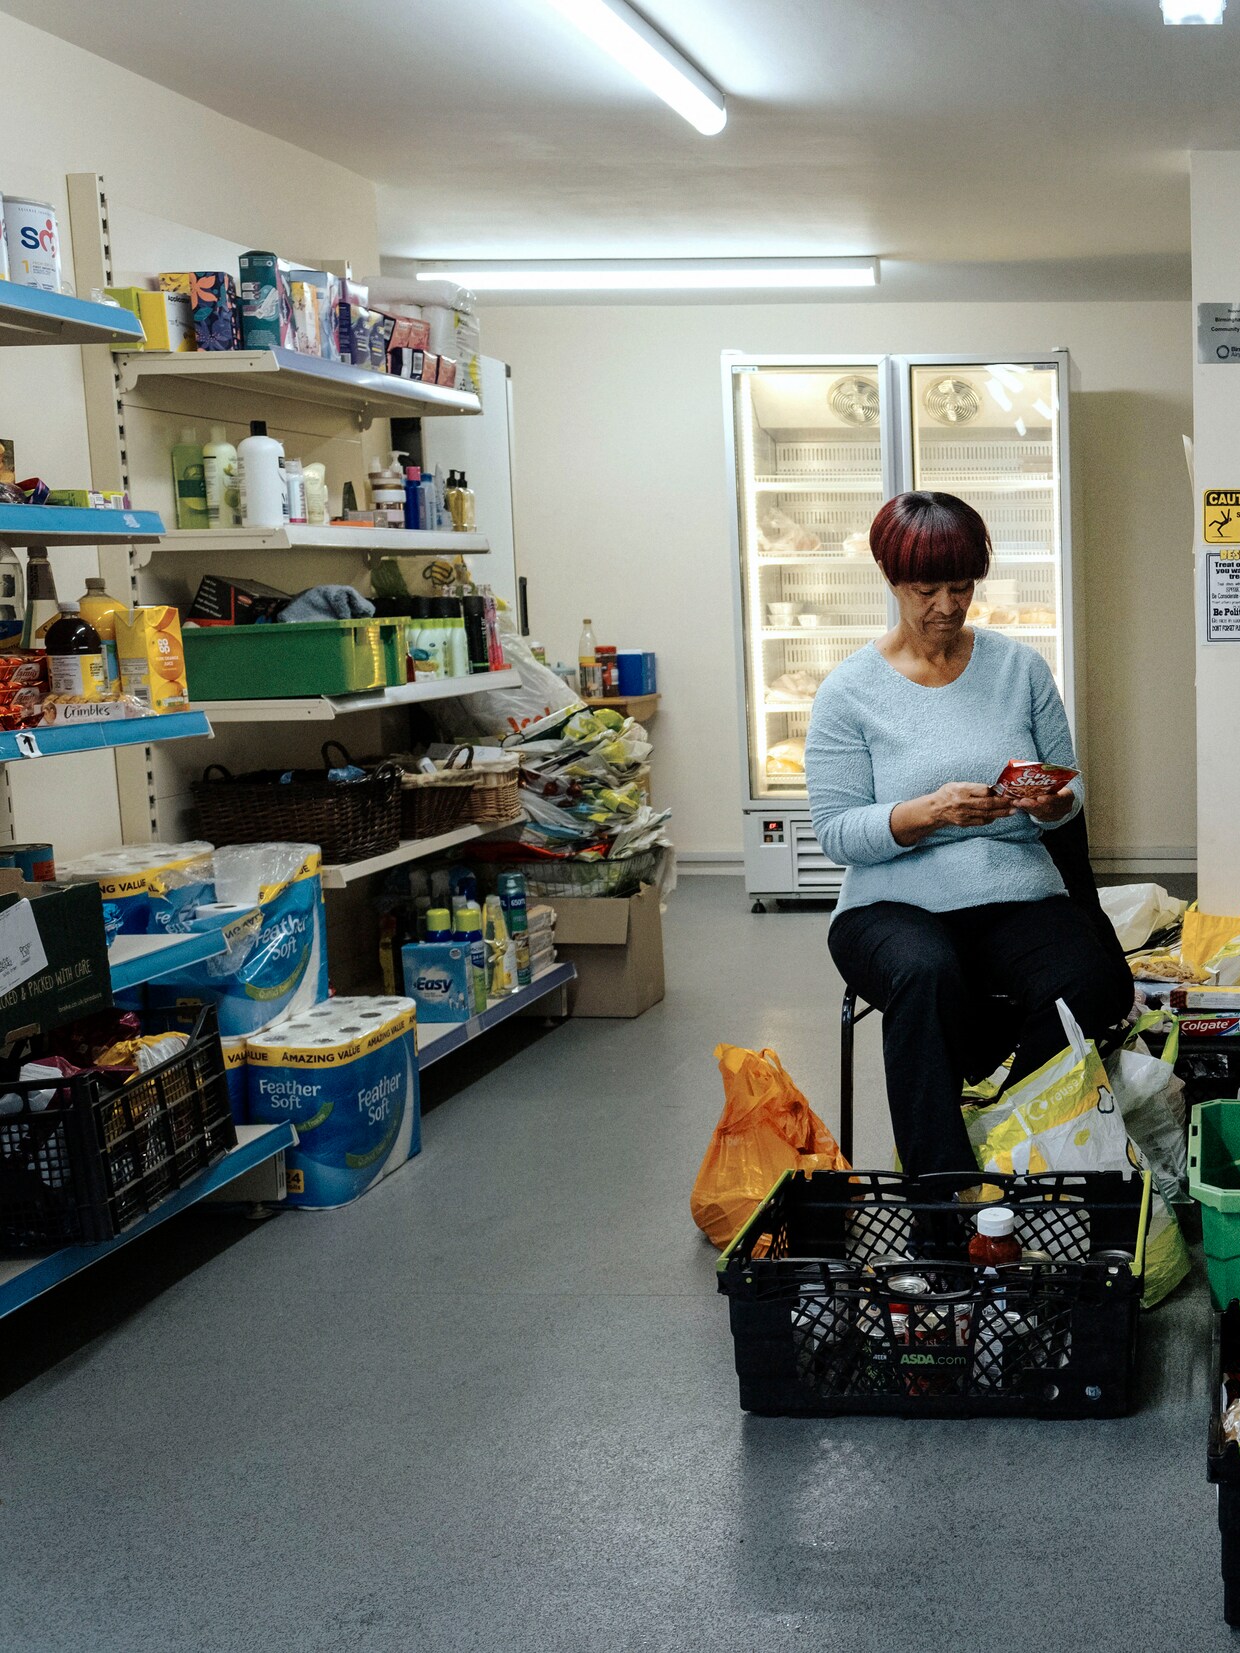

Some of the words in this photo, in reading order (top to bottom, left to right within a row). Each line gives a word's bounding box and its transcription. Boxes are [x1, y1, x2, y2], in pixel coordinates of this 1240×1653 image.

[21, 260, 29, 273] 1
[64, 705, 110, 719] Crimble's
[23, 736, 35, 754] 1
[120, 878, 146, 893] VALUE
[271, 937, 297, 961] Soft
[28, 976, 54, 997] PACKED
[55, 966, 73, 986] WITH
[74, 959, 92, 978] CARE
[416, 977, 453, 993] Easy
[367, 1030, 390, 1048] AMAZING
[390, 1020, 405, 1038] VALUE
[1181, 1020, 1228, 1032] Colgate
[282, 1052, 335, 1064] AMAZING
[338, 1044, 361, 1061] VALUE
[259, 1079, 321, 1098] Feather
[357, 1072, 401, 1112] Feather
[1050, 1081, 1080, 1105] reuse
[271, 1095, 302, 1110] Soft
[368, 1097, 390, 1127] Soft
[900, 1354, 967, 1365] ASDA.com
